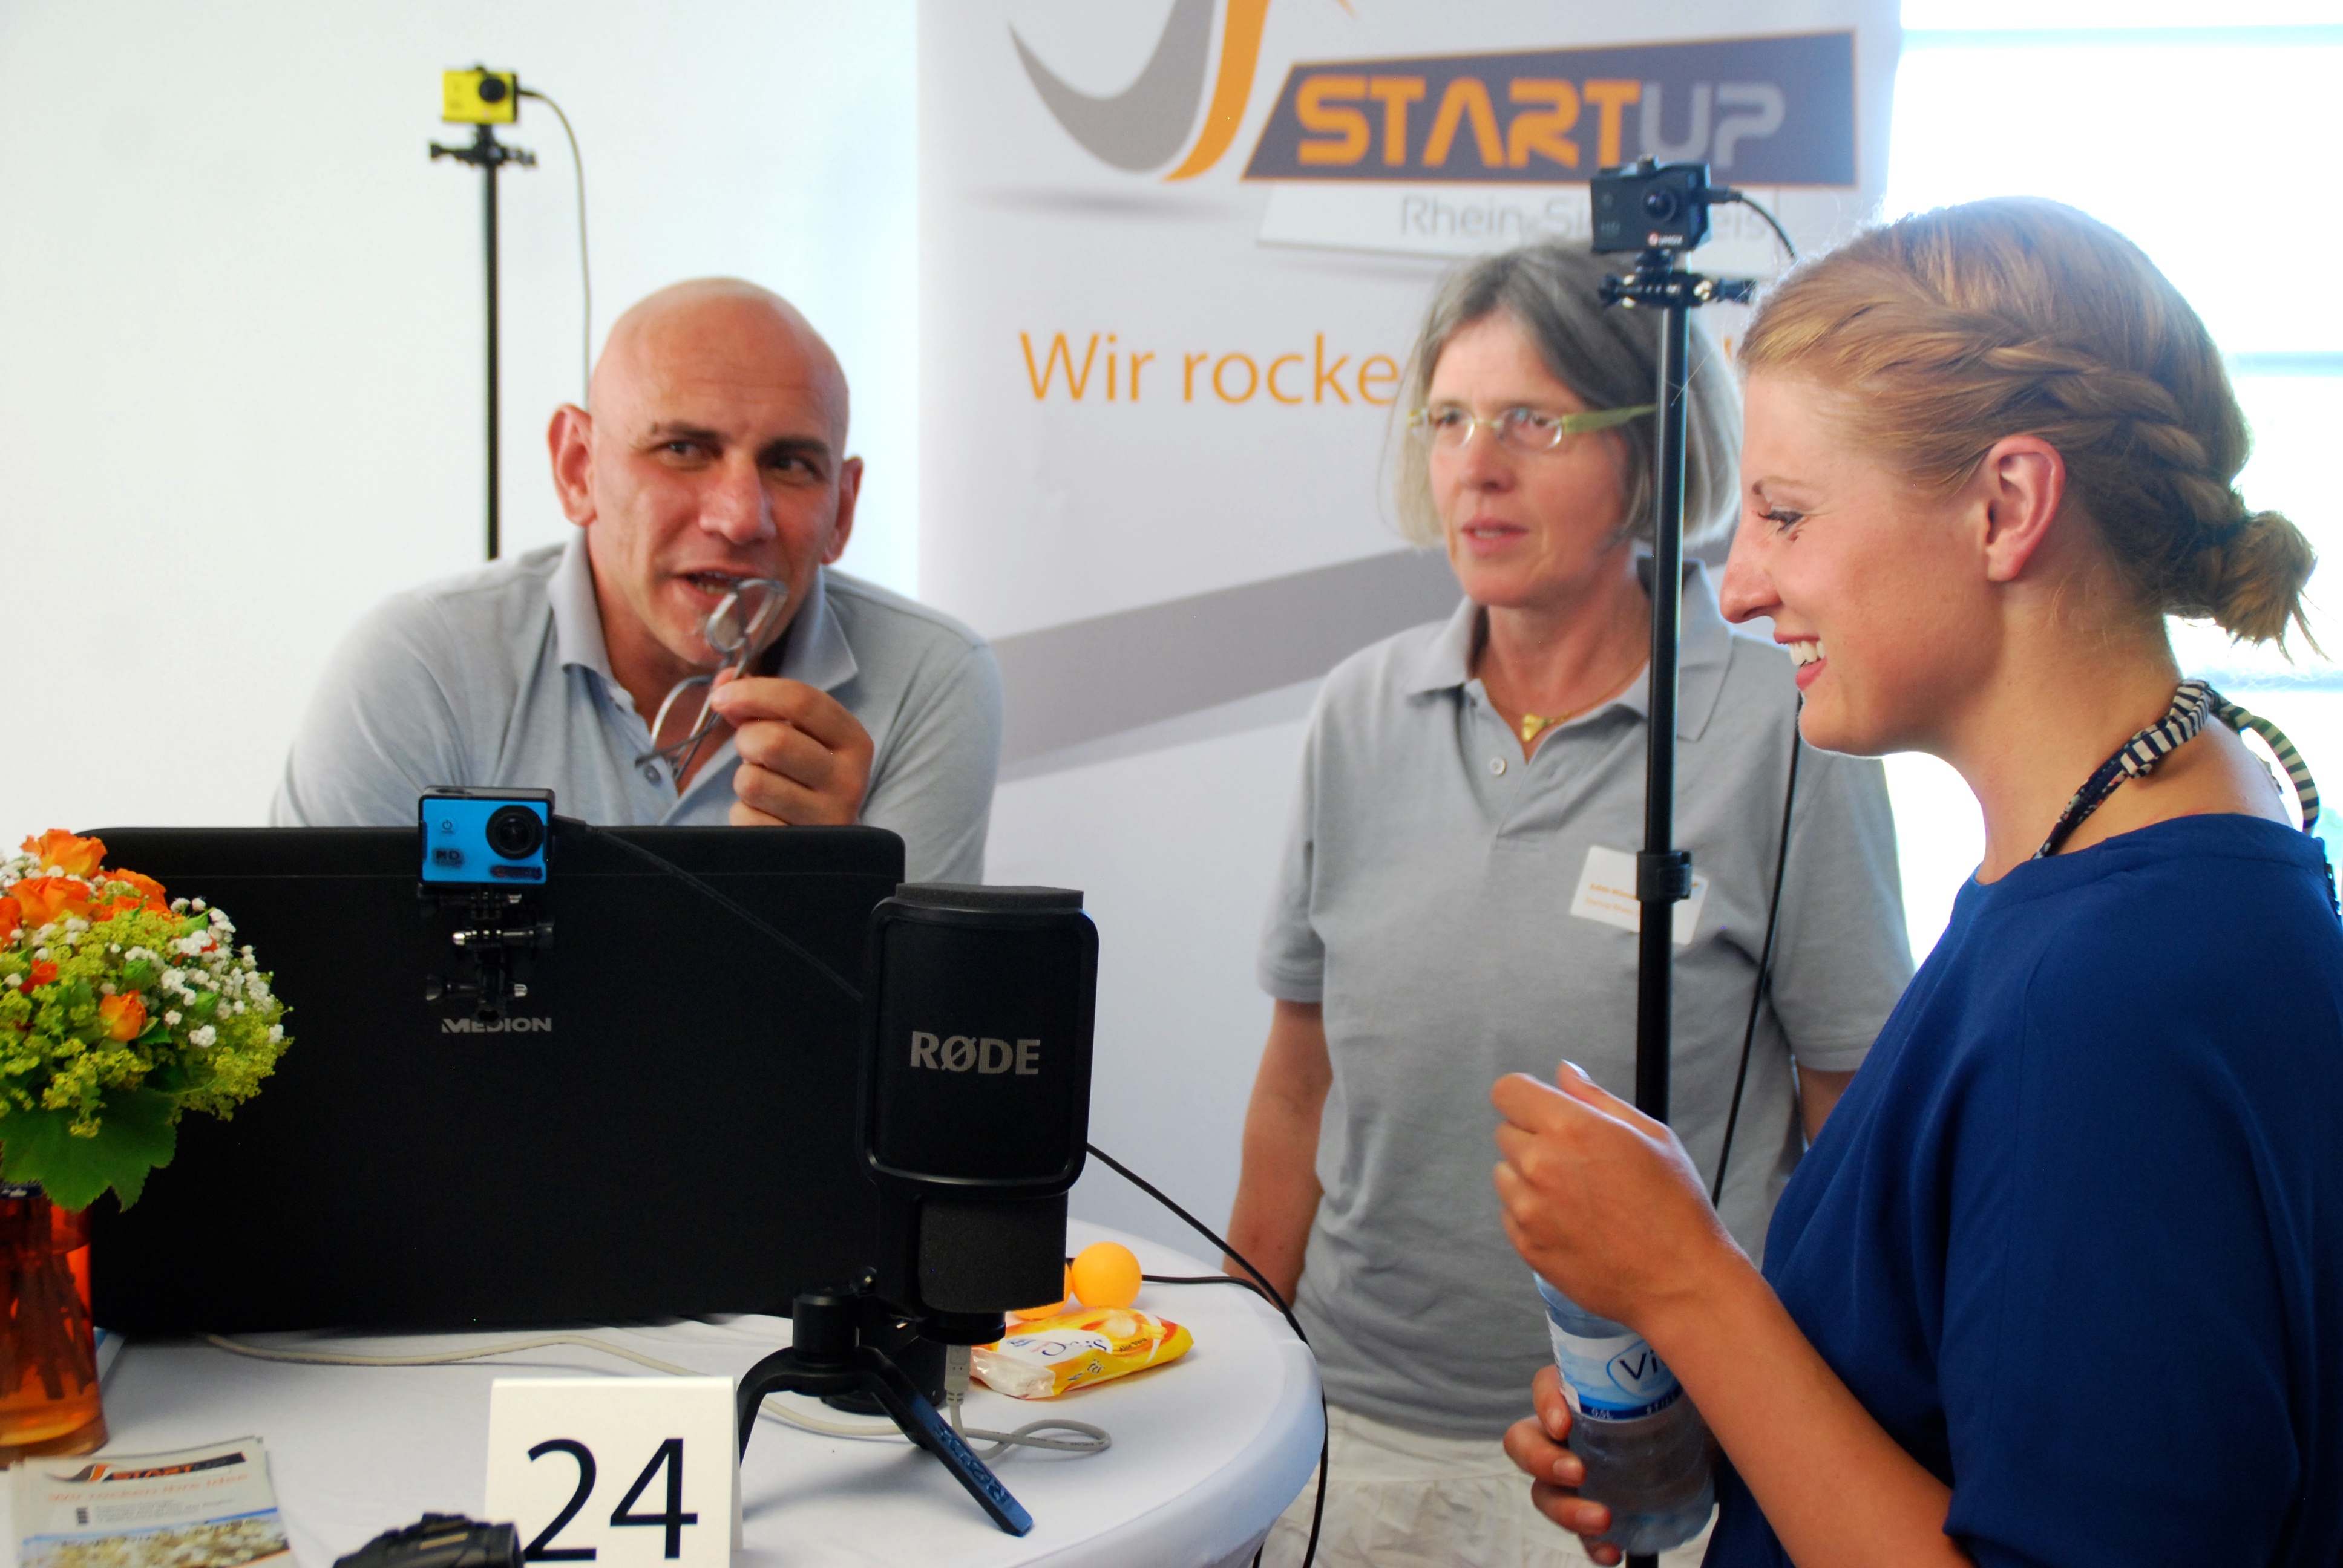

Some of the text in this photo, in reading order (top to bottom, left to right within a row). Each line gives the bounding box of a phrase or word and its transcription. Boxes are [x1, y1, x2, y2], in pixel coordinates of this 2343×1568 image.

[1294, 75, 1786, 171] STARTUP
[1020, 331, 1400, 405] Wir rocke
[441, 1017, 552, 1033] MEDION
[910, 1030, 1041, 1076] RØDE
[1119, 1343, 1132, 1353] Aloe
[1132, 1337, 1148, 1347] Vera
[1618, 1349, 1667, 1380] Vi
[522, 1438, 699, 1563] 24
